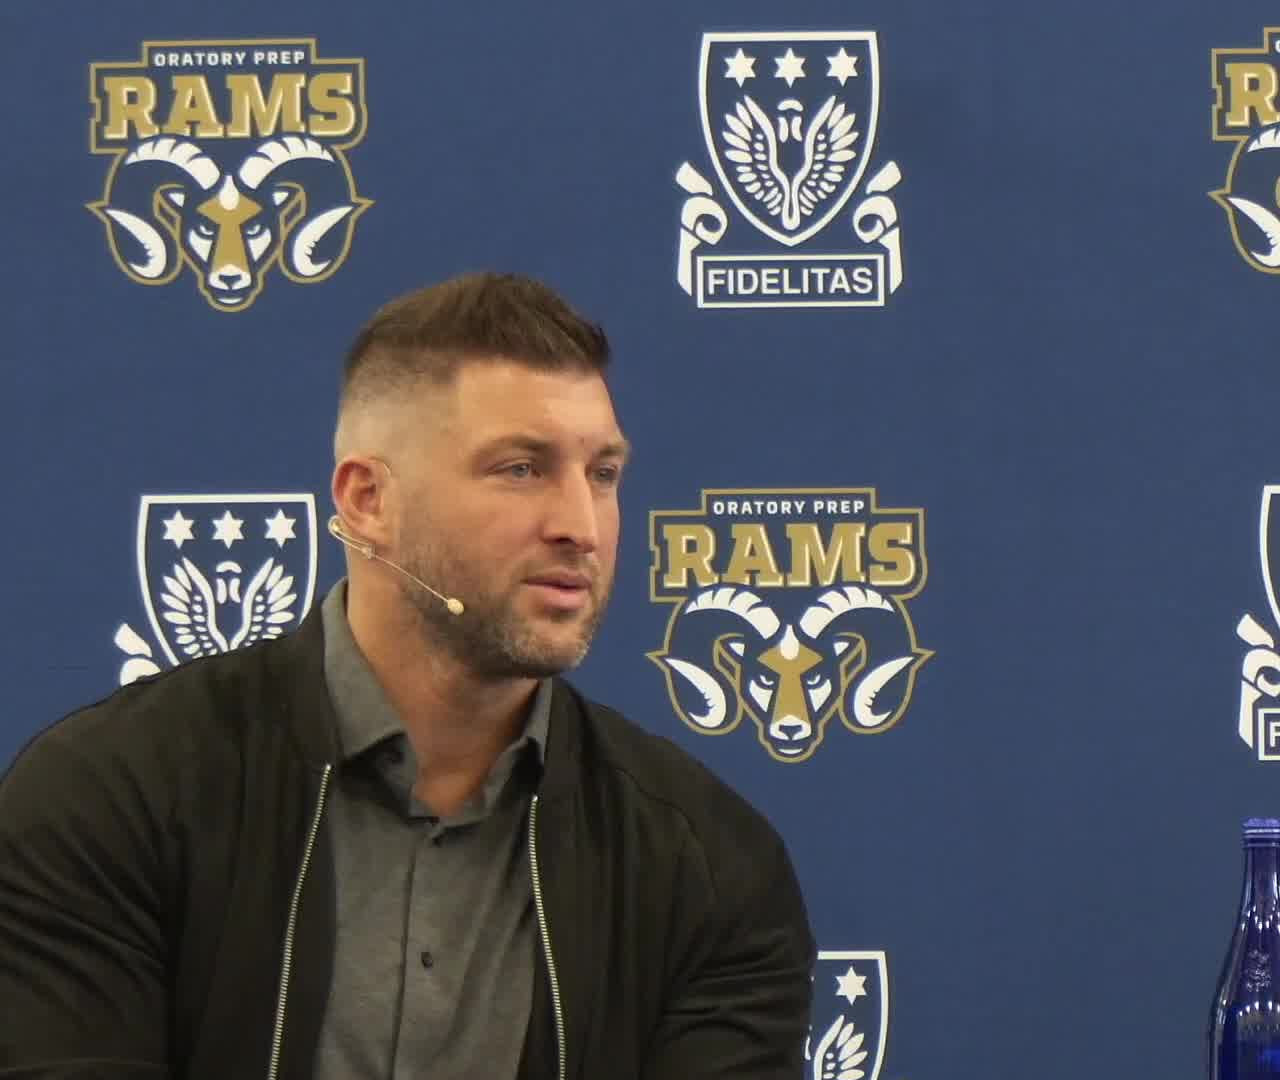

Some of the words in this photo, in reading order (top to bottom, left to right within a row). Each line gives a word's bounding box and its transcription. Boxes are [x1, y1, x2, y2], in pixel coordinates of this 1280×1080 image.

[154, 52, 246, 66] ORATORY
[254, 51, 304, 64] PREP
[105, 74, 354, 137] RAMS
[708, 267, 873, 294] FIDELITAS
[713, 501, 805, 514] ORATORY
[814, 500, 864, 513] PREP
[665, 523, 916, 587] RAMS
